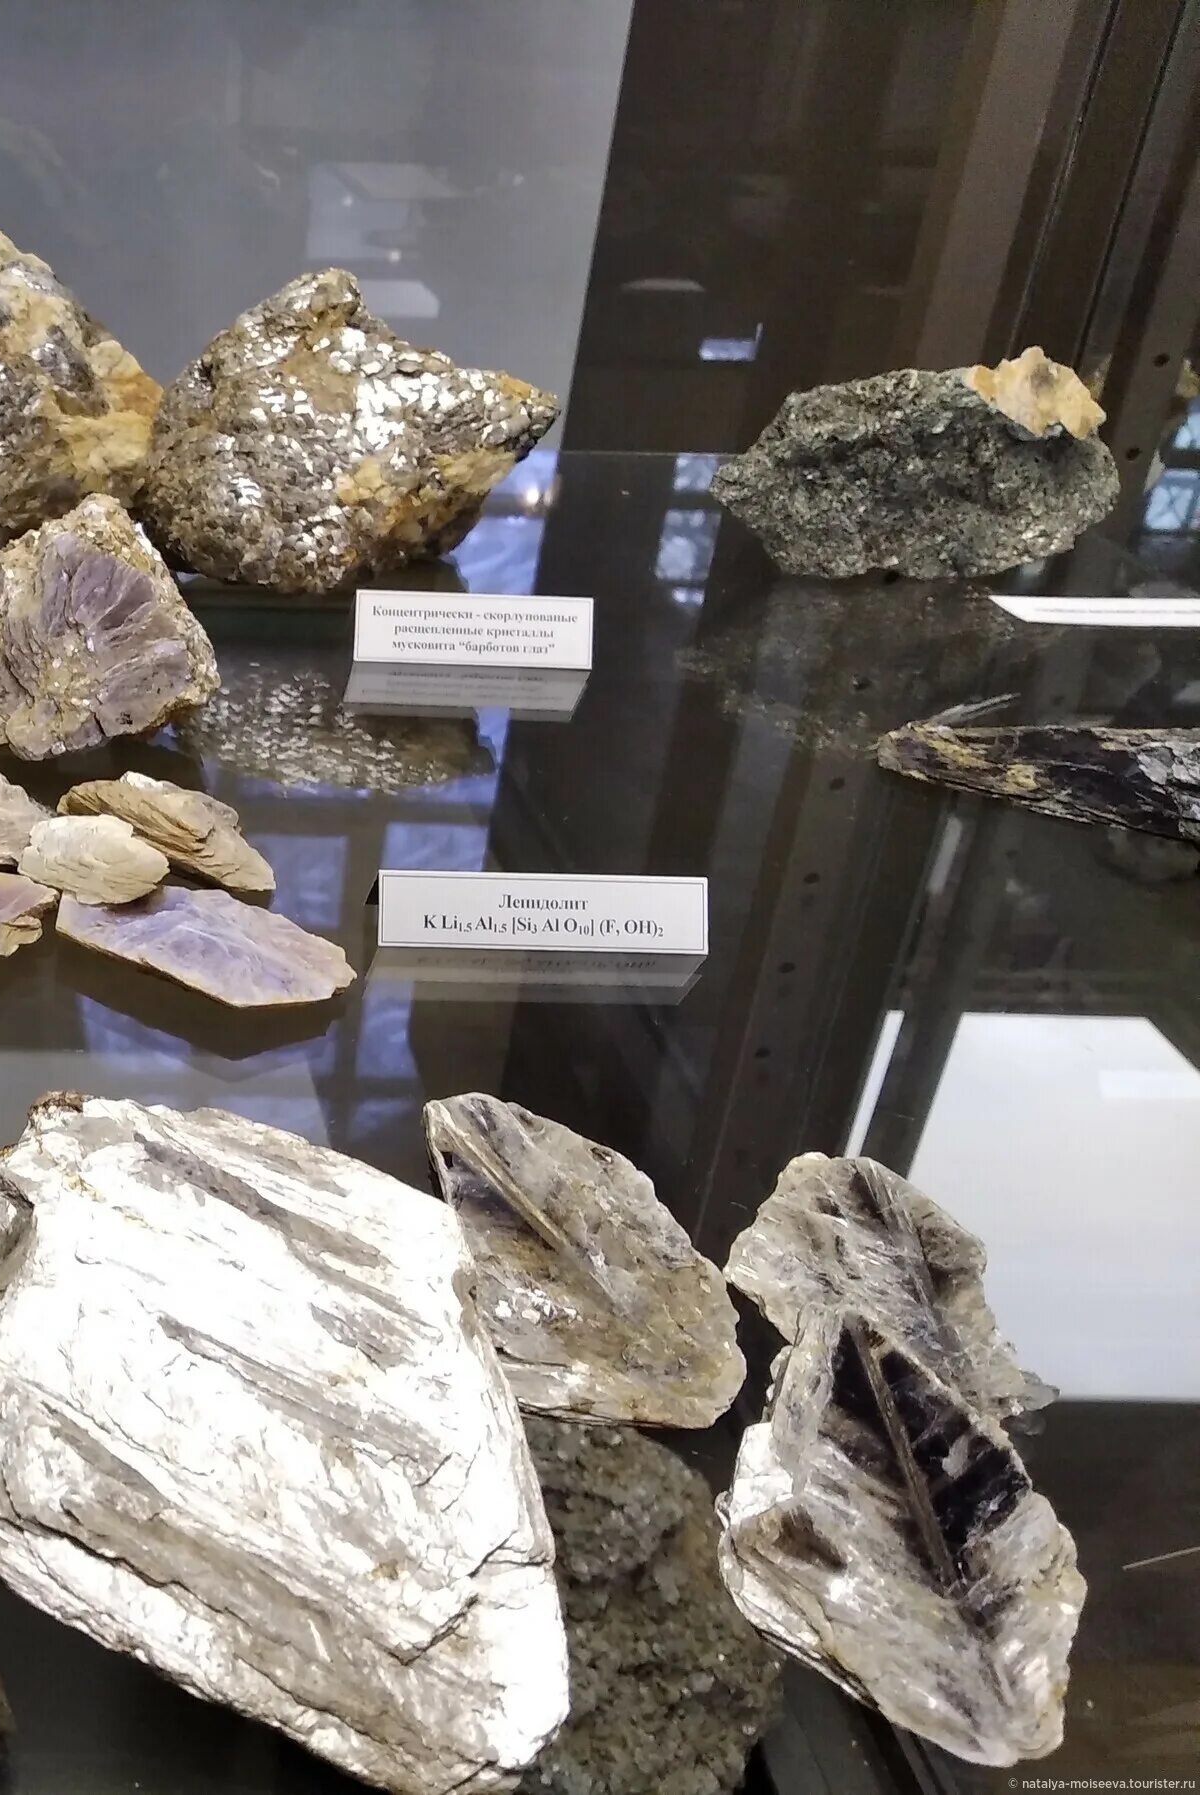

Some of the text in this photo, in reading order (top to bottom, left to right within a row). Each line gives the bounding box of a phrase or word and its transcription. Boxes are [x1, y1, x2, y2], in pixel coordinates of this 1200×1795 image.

[372, 605, 473, 620] Концентрически
[394, 625, 554, 639] расщепленные кристаллы
[392, 640, 456, 651] мусковита
[498, 894, 588, 910] Лепидолит
[424, 914, 437, 929] K
